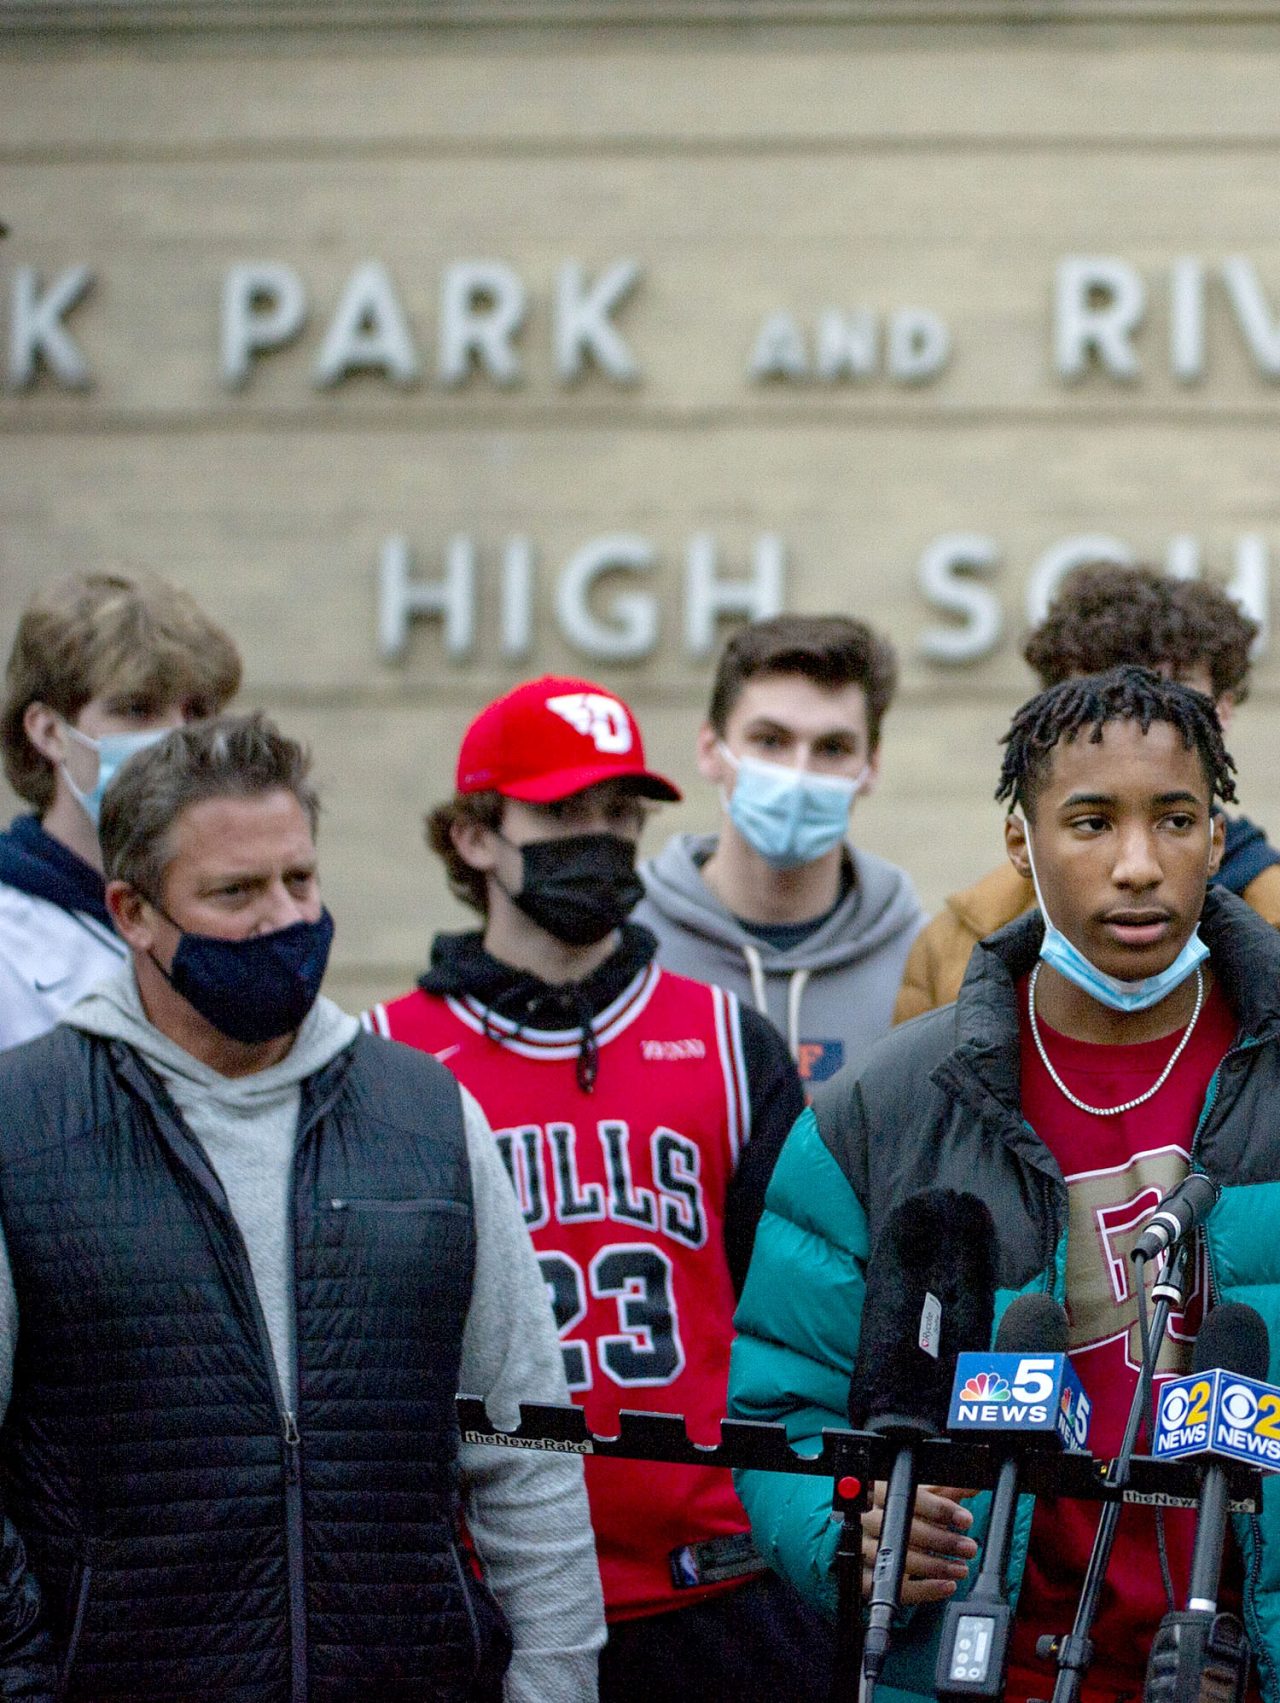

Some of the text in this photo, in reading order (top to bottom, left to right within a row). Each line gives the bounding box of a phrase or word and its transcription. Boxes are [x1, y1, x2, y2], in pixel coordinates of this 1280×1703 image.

[220, 258, 642, 392] PARK
[748, 309, 952, 384] AND
[378, 532, 786, 661] HIGH
[533, 1242, 686, 1394] 23
[1012, 1359, 1055, 1404] 5
[1185, 1380, 1211, 1427] 2
[957, 1404, 1048, 1423] NEWS
[1057, 1414, 1082, 1451] NEW
[1074, 1393, 1090, 1445] 5
[1157, 1423, 1207, 1452] NEWS
